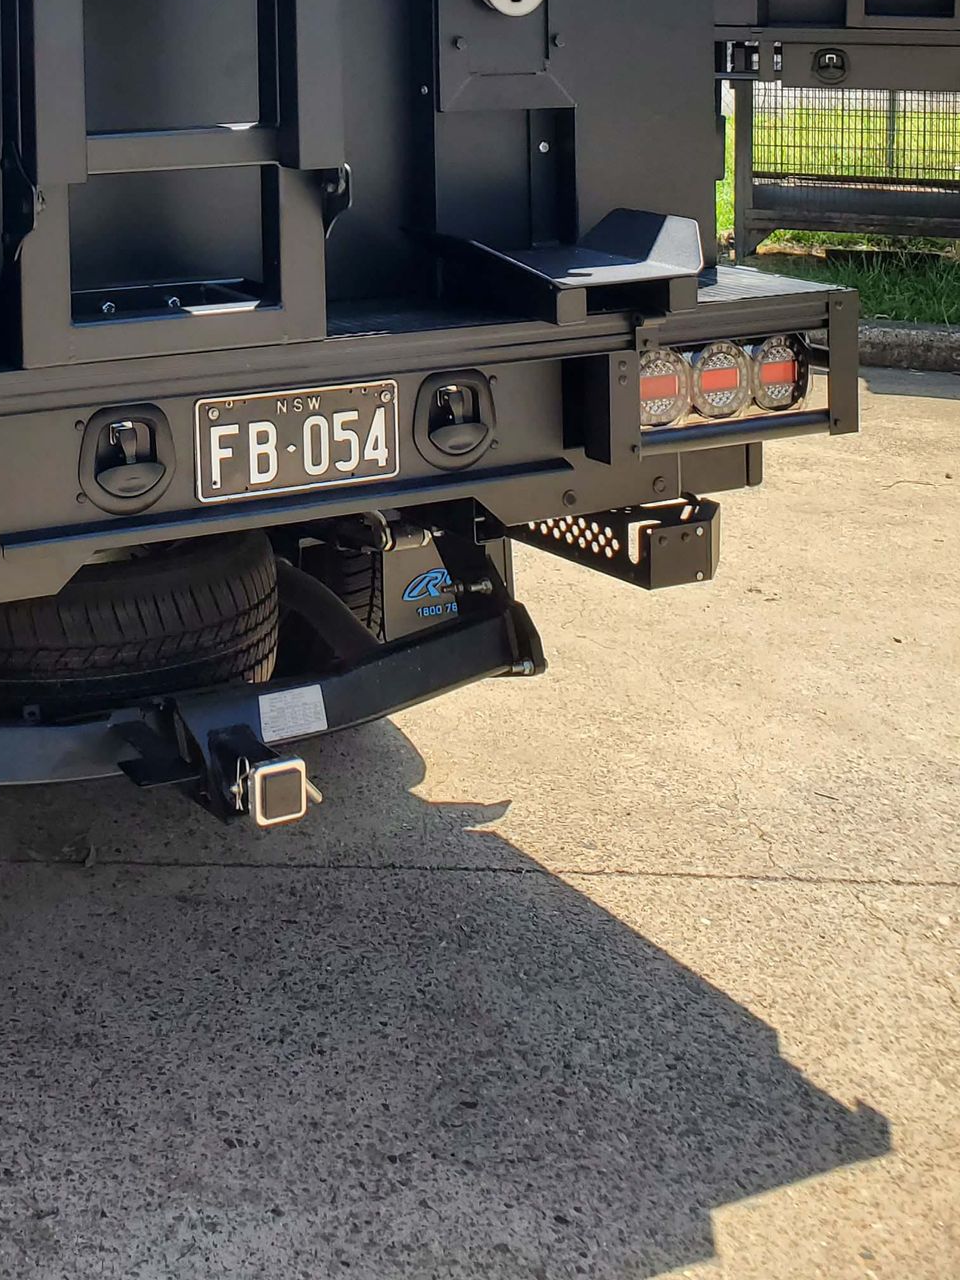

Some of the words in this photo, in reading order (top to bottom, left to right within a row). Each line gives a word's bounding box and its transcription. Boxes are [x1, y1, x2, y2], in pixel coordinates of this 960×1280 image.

[276, 396, 321, 415] NSW
[417, 604, 443, 617] 1800
[445, 602, 458, 613] 76
